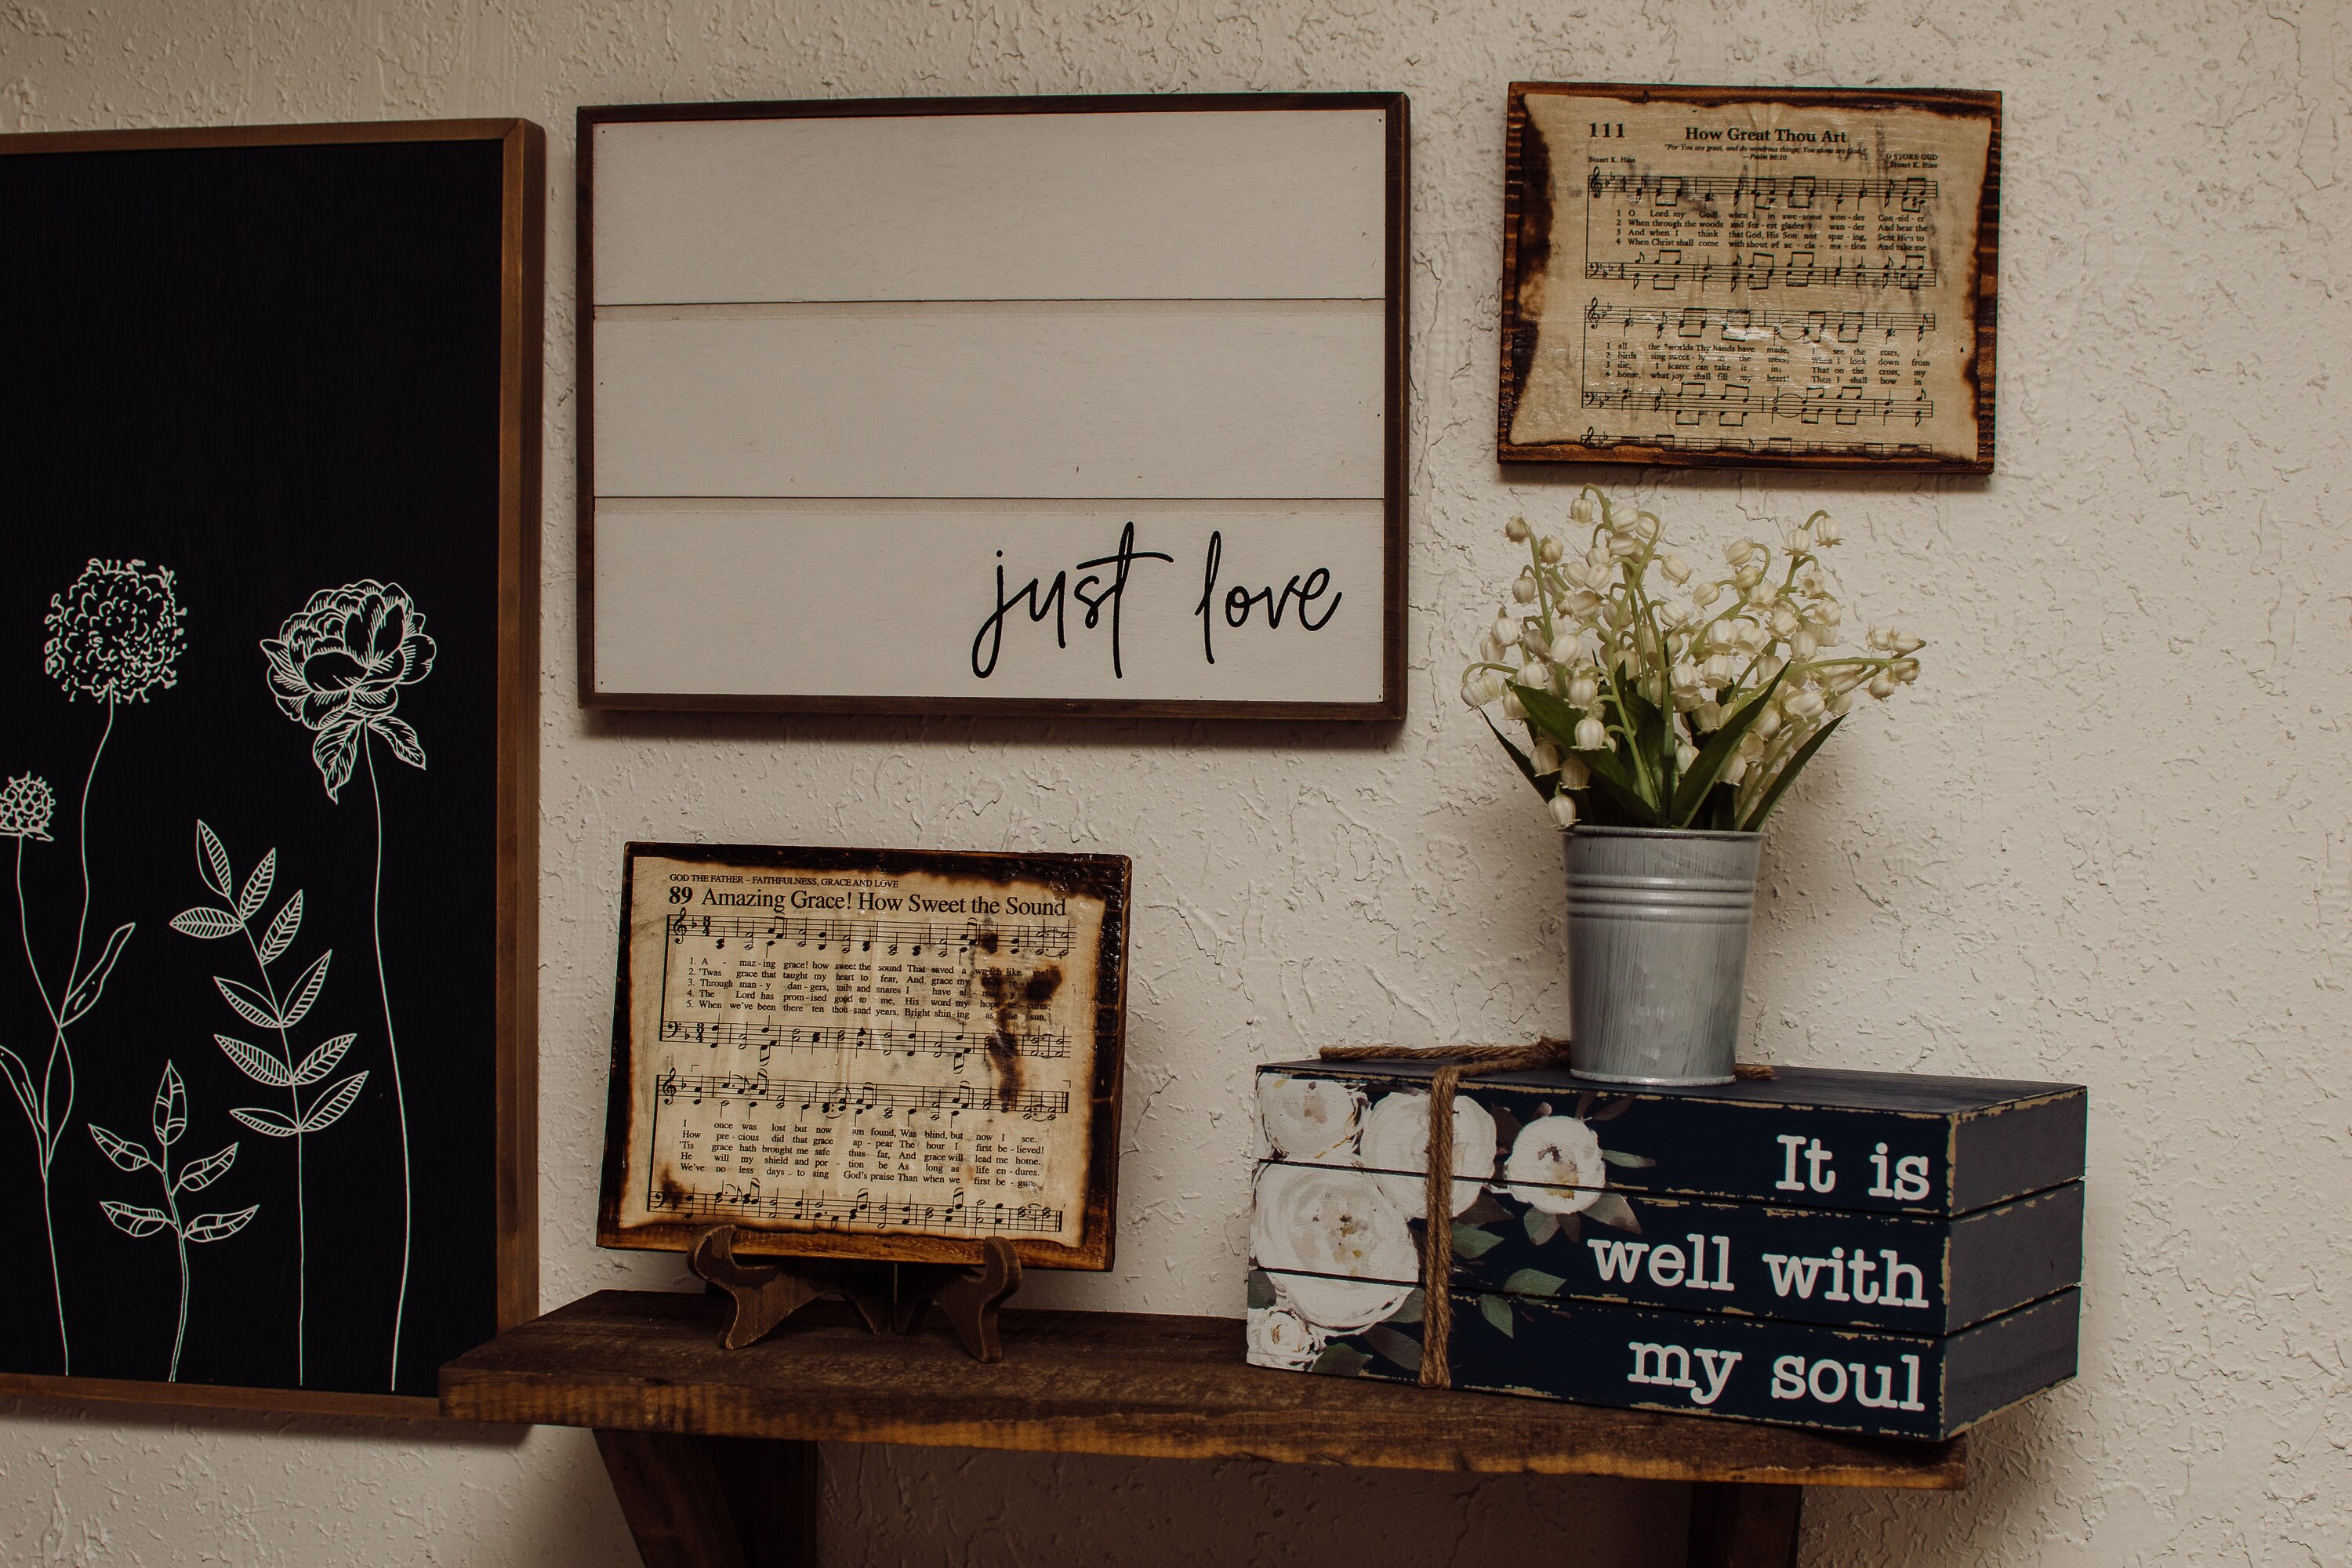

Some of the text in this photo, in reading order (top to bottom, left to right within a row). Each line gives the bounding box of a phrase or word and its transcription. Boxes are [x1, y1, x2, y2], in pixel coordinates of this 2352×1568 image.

[1589, 122, 1846, 143] 111 How Great Thou Art
[1671, 372, 1684, 381] joy
[972, 521, 1342, 679] just love
[753, 877, 819, 886] FAITHFULNESS,
[822, 878, 851, 887] GRACE
[874, 880, 898, 888] LOVE
[670, 886, 1066, 916] 89 Amazing Grace! How Sweet the Sound
[784, 961, 808, 970] grace!
[931, 965, 953, 974] saved
[700, 979, 732, 989] Through
[736, 971, 757, 979] grace
[783, 971, 808, 981] taught
[931, 978, 953, 986] grace
[736, 991, 755, 1000] Lord
[834, 995, 853, 1004] good
[784, 1004, 803, 1012] there
[905, 1008, 930, 1018] Bright
[772, 1134, 784, 1143] did
[813, 1138, 833, 1146] grace
[870, 1128, 896, 1137] found,
[925, 1131, 947, 1140] blind,
[712, 1143, 733, 1152] grace
[739, 1143, 756, 1152] hath
[762, 1145, 793, 1154] brought
[877, 1150, 890, 1159] far,
[975, 1154, 991, 1163] lead
[681, 1163, 705, 1171] We've
[767, 1167, 784, 1176] days
[813, 1170, 829, 1178] sing
[844, 1171, 867, 1179] God's
[870, 1172, 894, 1181] praise
[898, 1173, 917, 1181] Than
[924, 1174, 944, 1183] when
[764, 1156, 788, 1165] shield
[925, 1163, 943, 1173] long
[976, 1166, 989, 1174] life
[1776, 1134, 1929, 1200] It is
[1588, 1234, 1929, 1308] well with
[1629, 1341, 1924, 1412] my soul
